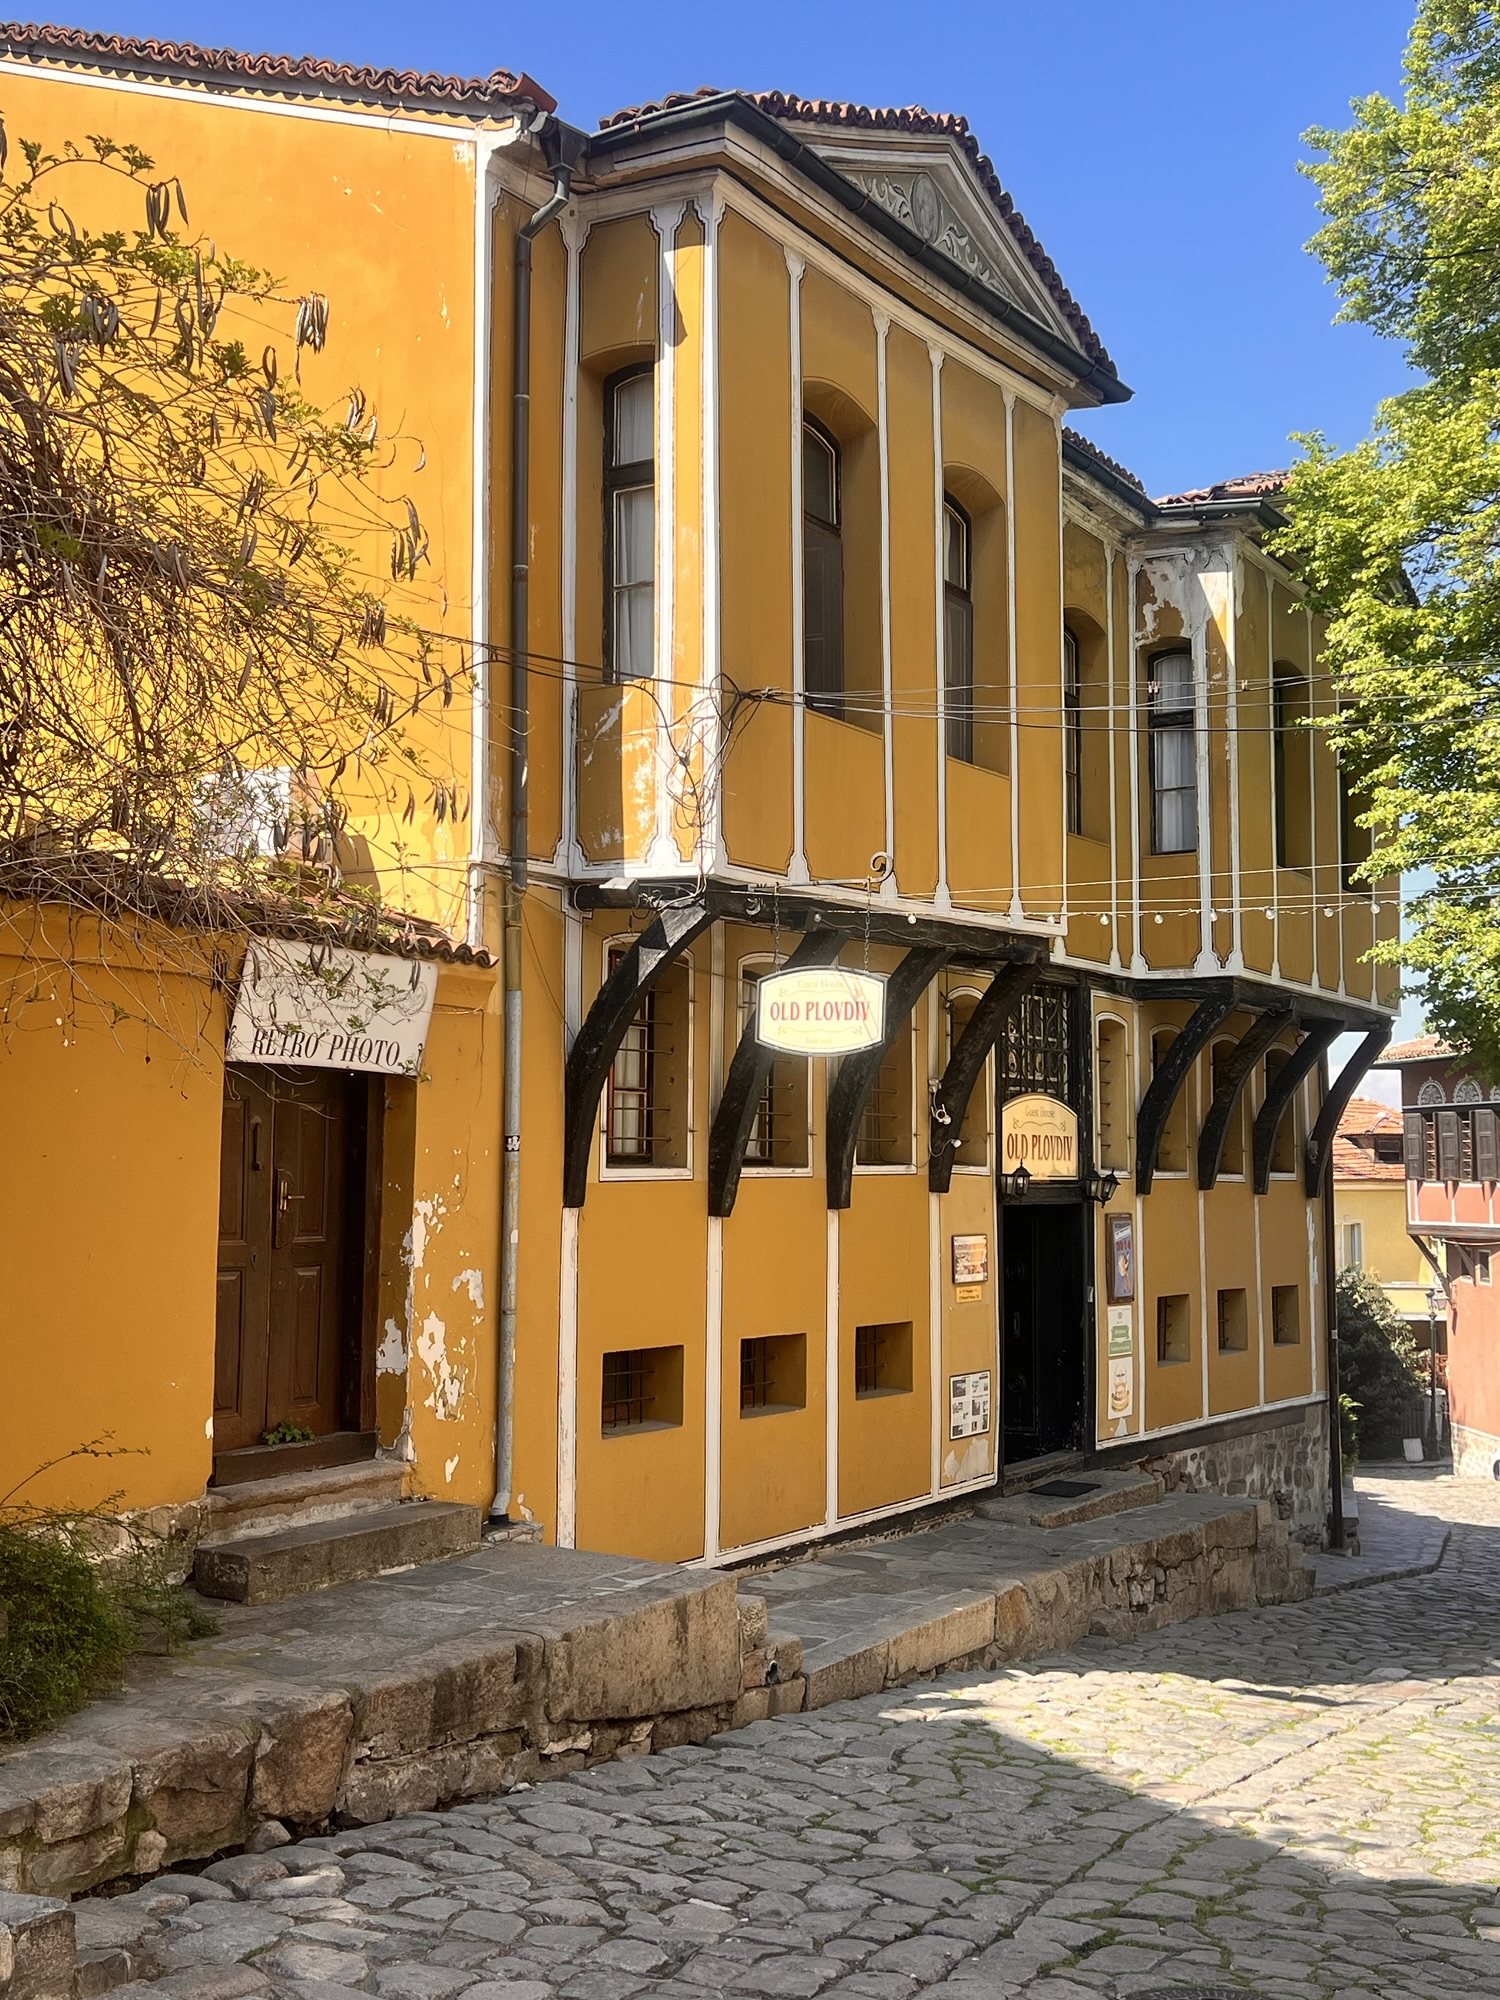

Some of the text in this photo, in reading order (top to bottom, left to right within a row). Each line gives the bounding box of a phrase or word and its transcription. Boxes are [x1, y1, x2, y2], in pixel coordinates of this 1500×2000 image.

[770, 1001, 870, 1021] OLD PLOVDIV
[250, 1028, 400, 1066] RETRO PHOTO
[1007, 1133, 1073, 1161] OLD PLOVDIV
